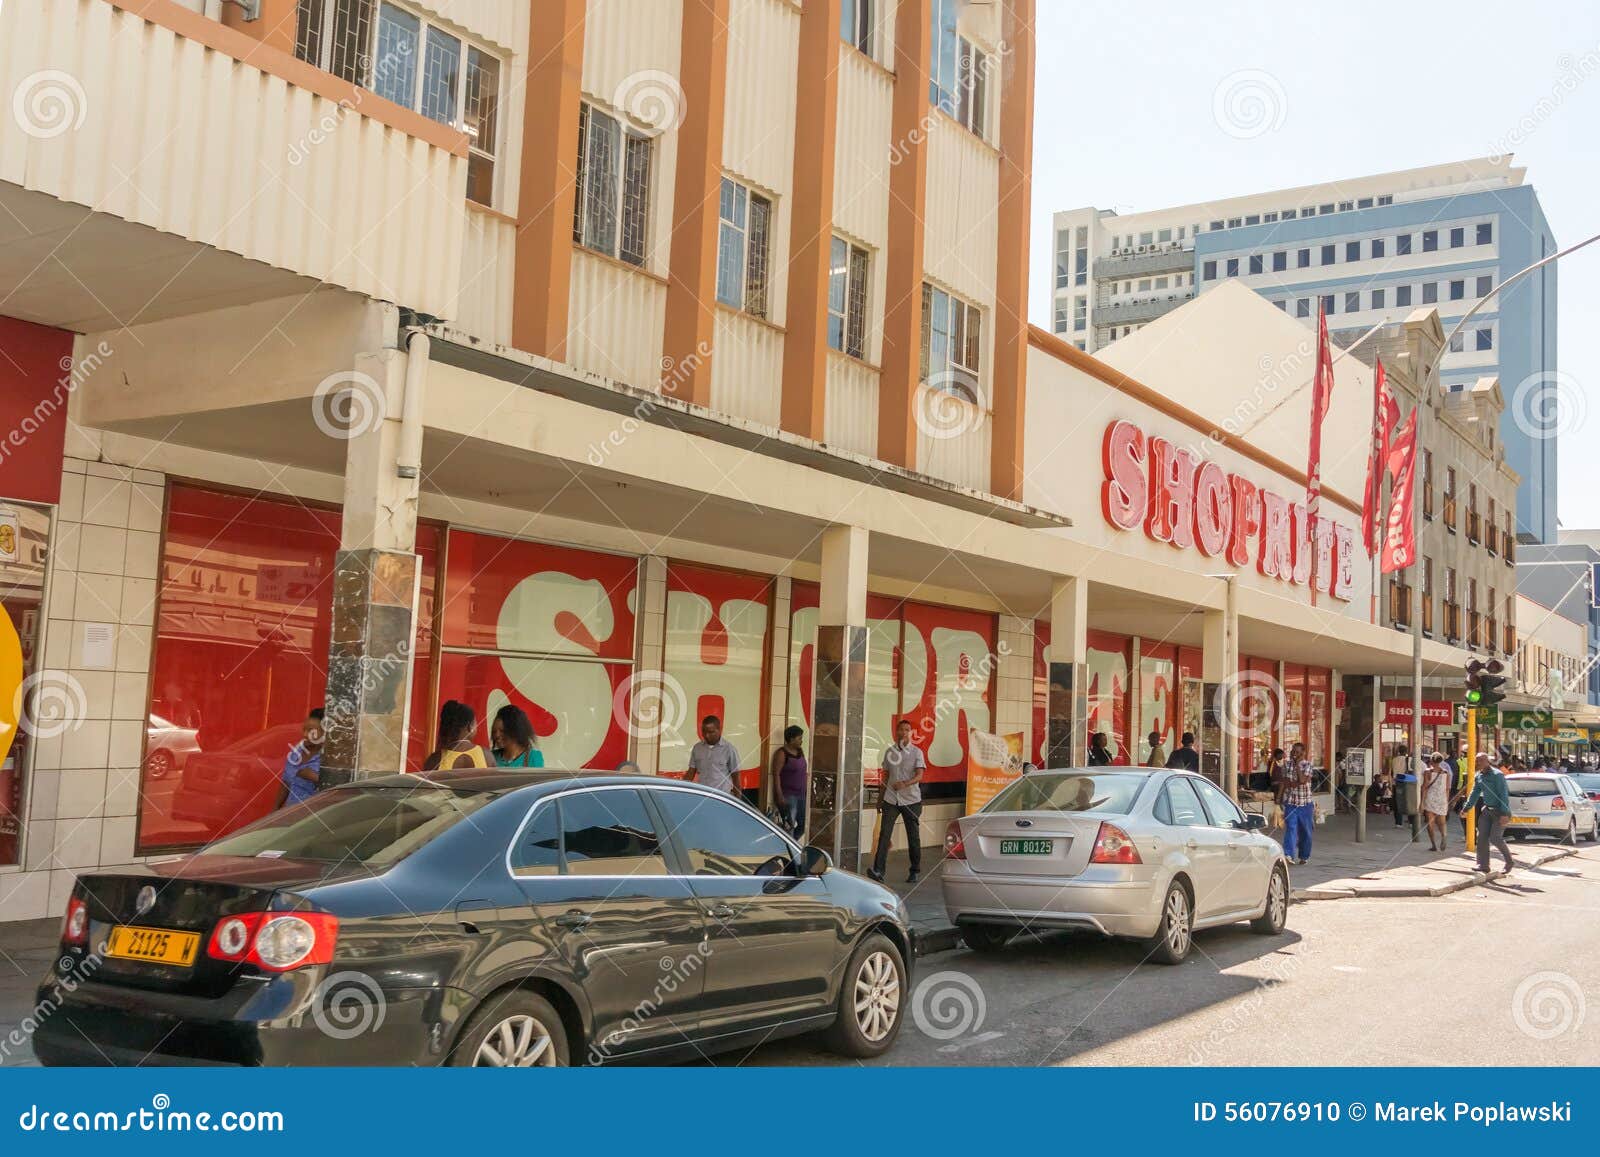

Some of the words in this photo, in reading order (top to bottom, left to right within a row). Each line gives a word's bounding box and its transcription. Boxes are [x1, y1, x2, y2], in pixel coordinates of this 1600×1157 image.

[1100, 419, 1352, 602] SHOPRITE
[1389, 708, 1449, 717] SHORITE
[1002, 841, 1019, 853] GRN
[1023, 841, 1051, 853] 80125
[128, 931, 171, 957] 21125
